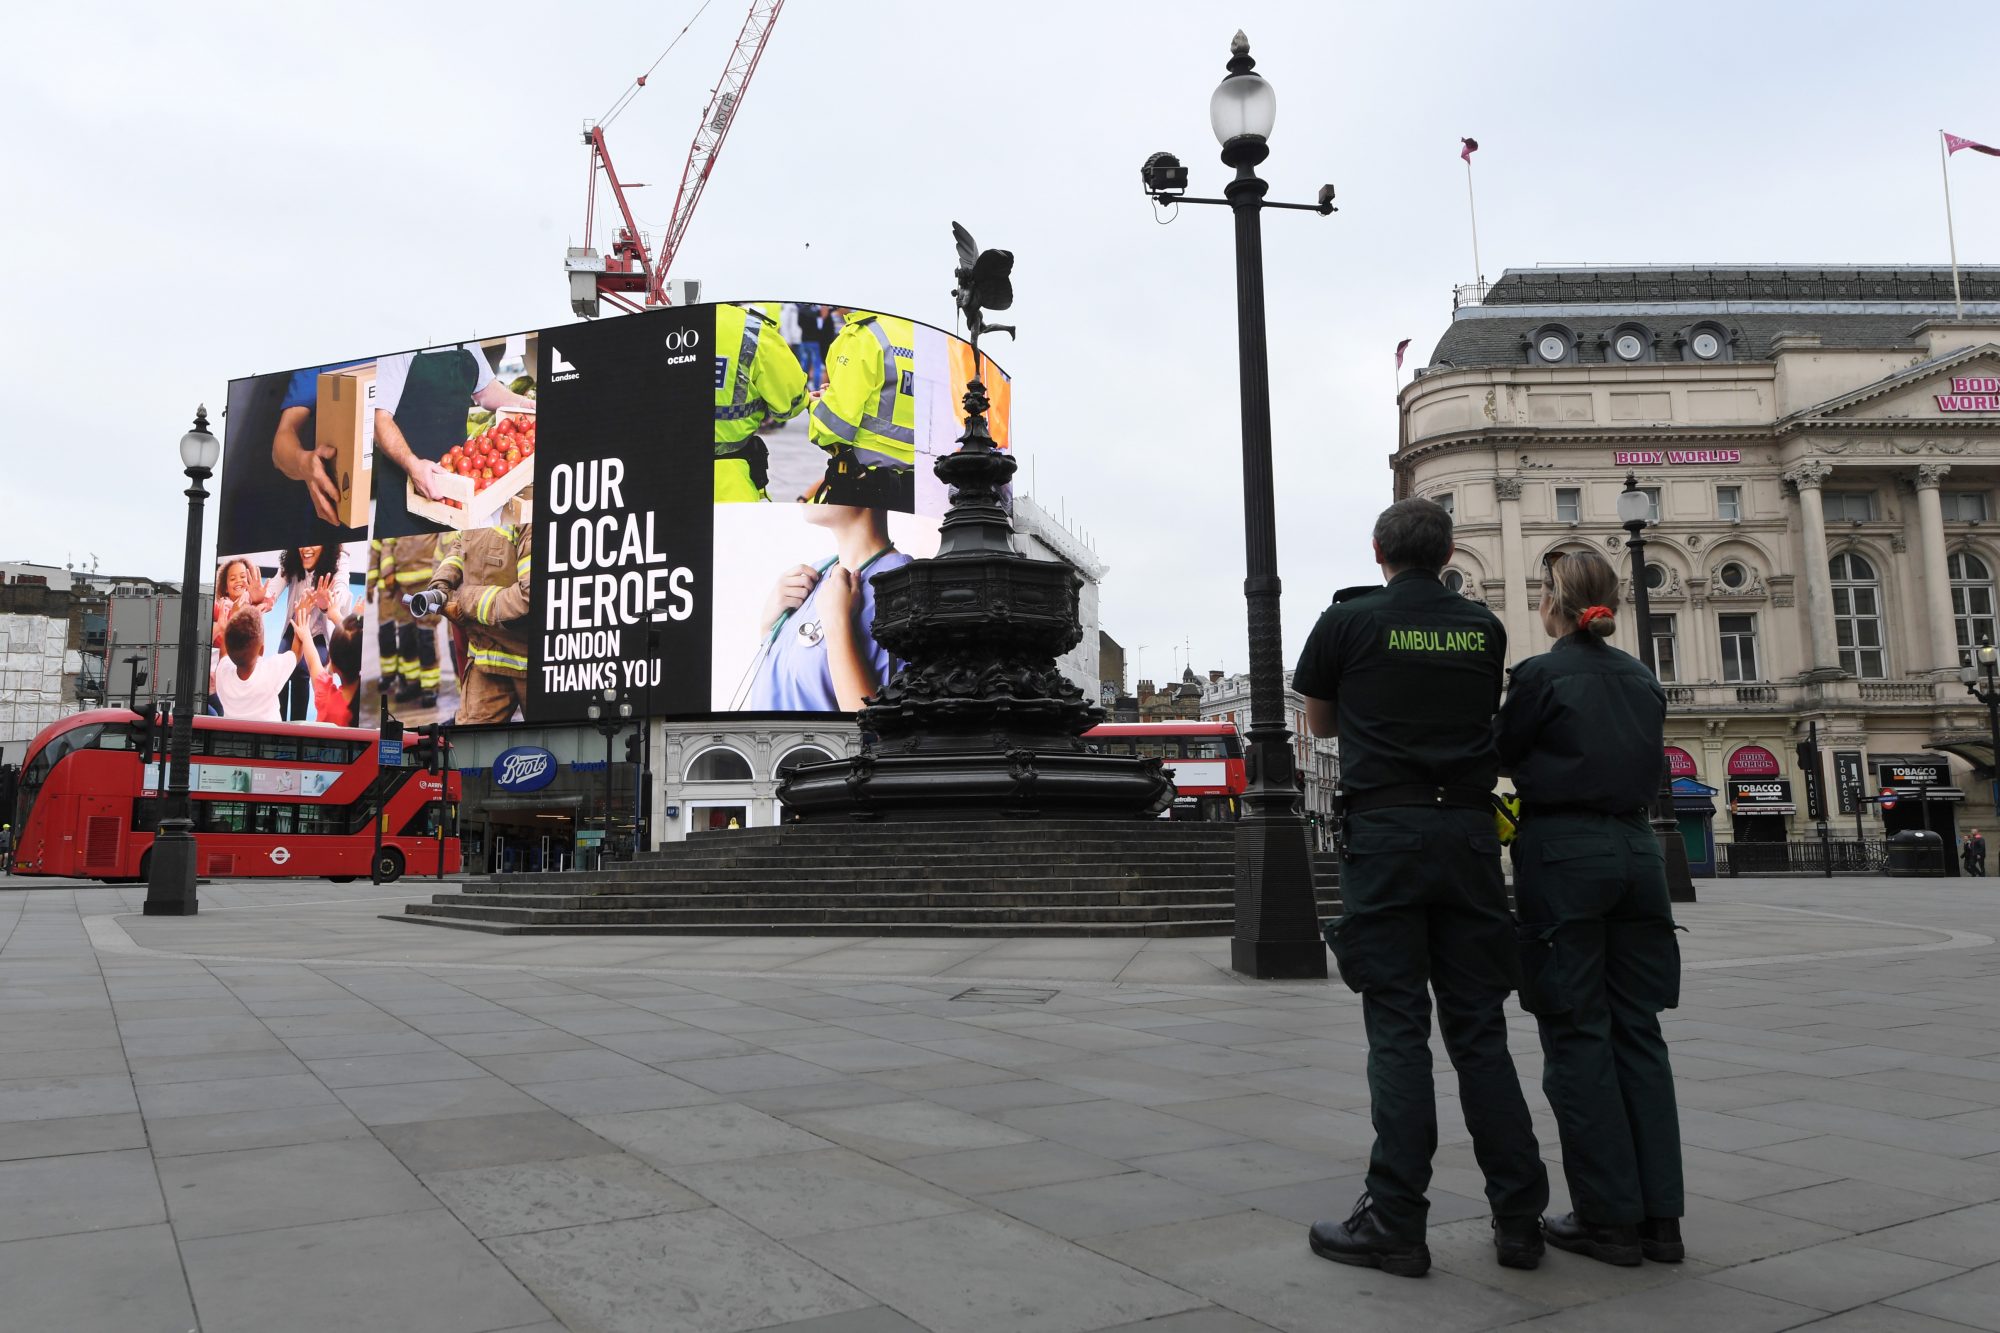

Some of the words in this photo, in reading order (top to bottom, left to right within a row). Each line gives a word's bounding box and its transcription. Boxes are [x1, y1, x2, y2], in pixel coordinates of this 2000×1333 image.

[667, 354, 697, 365] OCEAN
[551, 372, 580, 382] Landsec
[1951, 377, 2000, 393] BOD
[1937, 395, 2000, 412] WORL
[1615, 452, 1664, 464] BODY
[1667, 450, 1740, 464] WORLDS
[549, 457, 625, 515] OUR
[548, 511, 667, 572] LOCAL
[546, 567, 694, 630] HEROES
[543, 629, 620, 661] LONDON
[1388, 629, 1485, 651] AMBULANCE
[542, 661, 617, 693] THANKS
[622, 658, 661, 688] YOU
[498, 754, 548, 784] Boots
[1737, 784, 1782, 792] TOBACCO
[1840, 760, 1851, 812] TOBACCO
